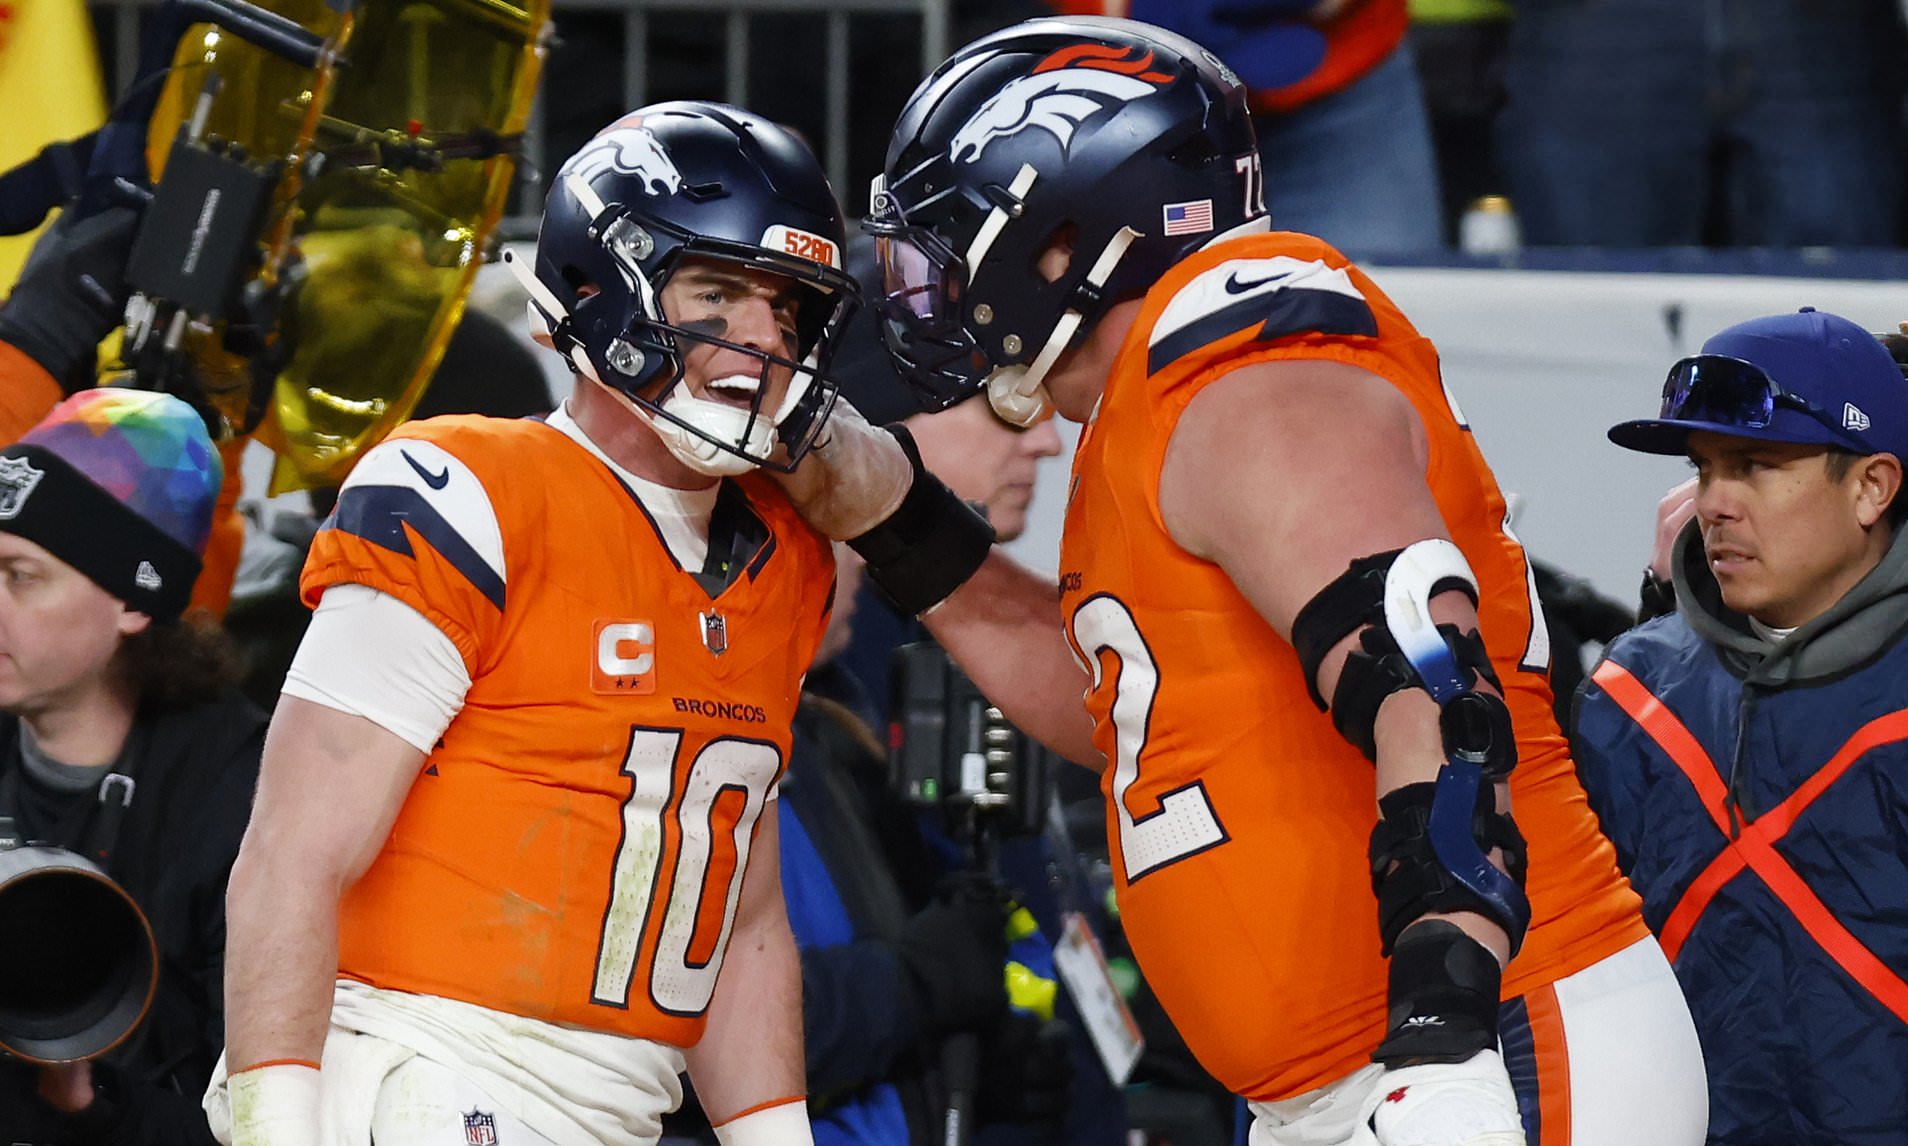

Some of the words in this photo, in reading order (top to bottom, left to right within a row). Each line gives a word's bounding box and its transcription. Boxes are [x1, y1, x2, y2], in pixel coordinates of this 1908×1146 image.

[784, 231, 833, 267] 5280
[598, 623, 654, 676] C
[672, 697, 766, 723] BRONCOS
[589, 724, 783, 1016] 10
